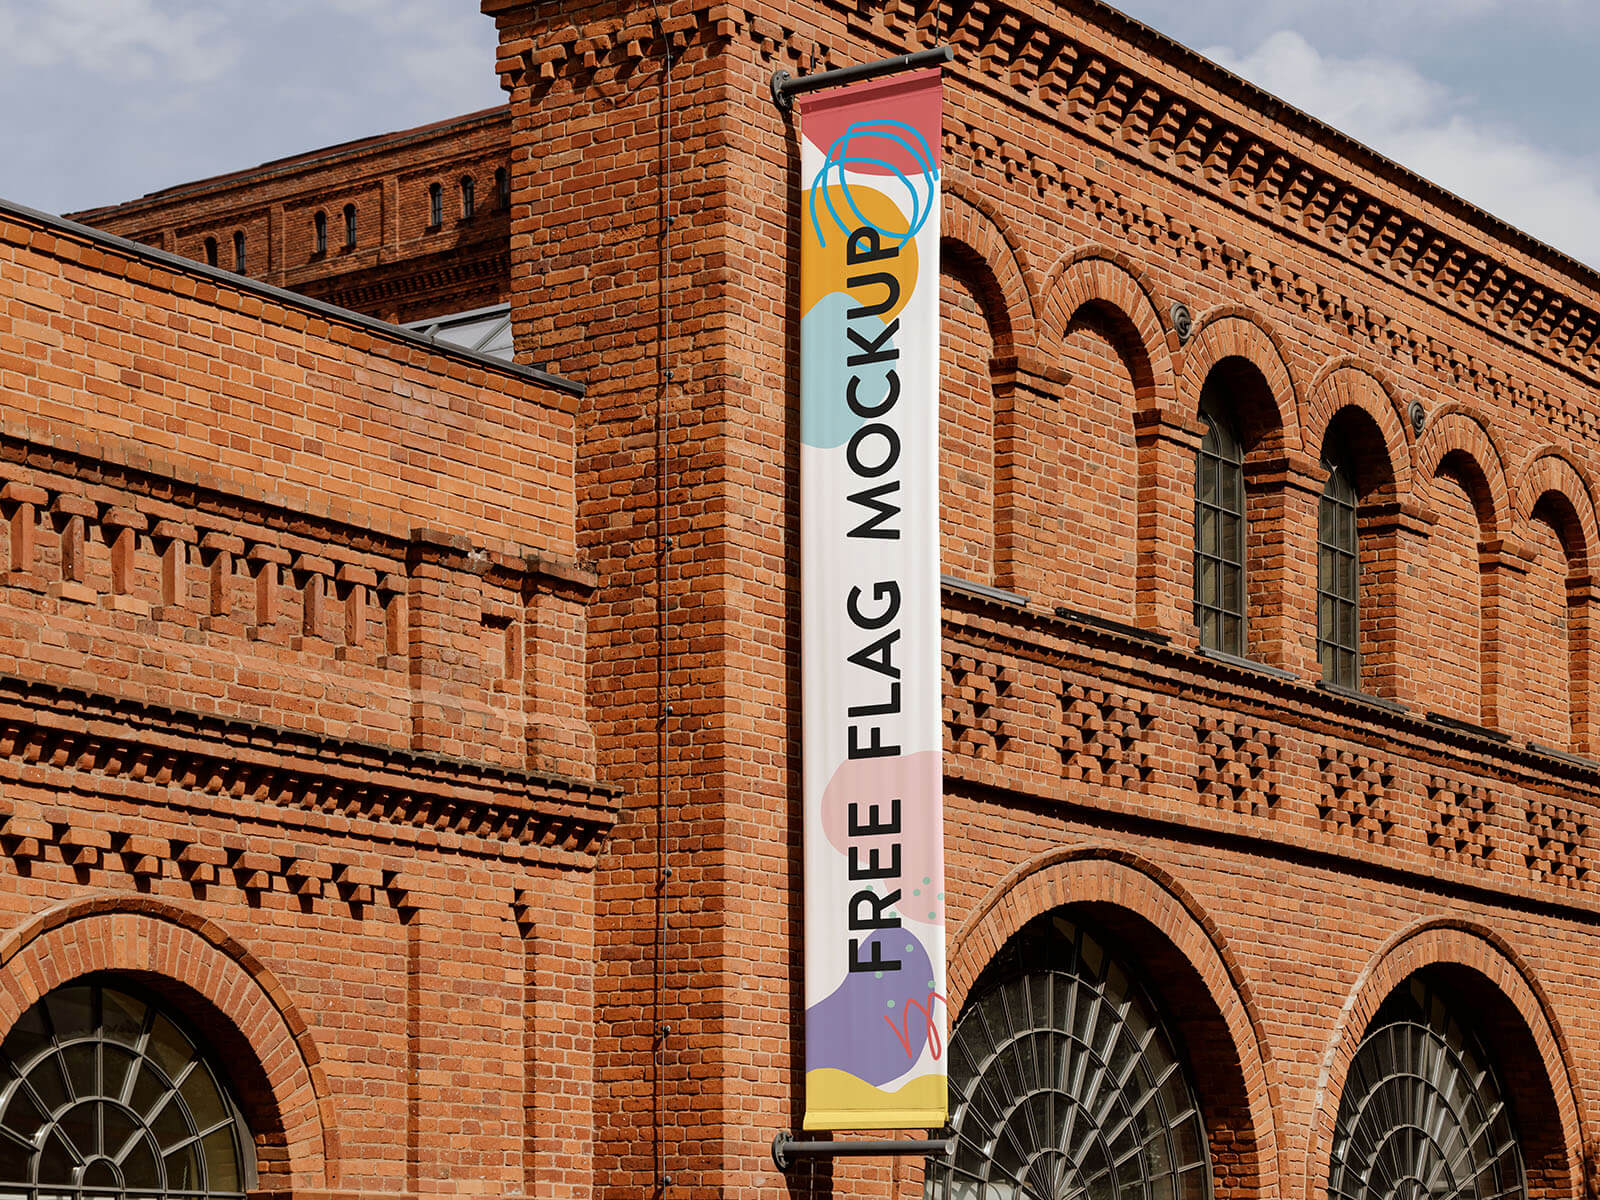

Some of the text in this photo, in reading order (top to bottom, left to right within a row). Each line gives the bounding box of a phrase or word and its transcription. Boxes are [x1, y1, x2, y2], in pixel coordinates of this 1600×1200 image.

[846, 226, 902, 973] FREE FLAG MOCKUP
